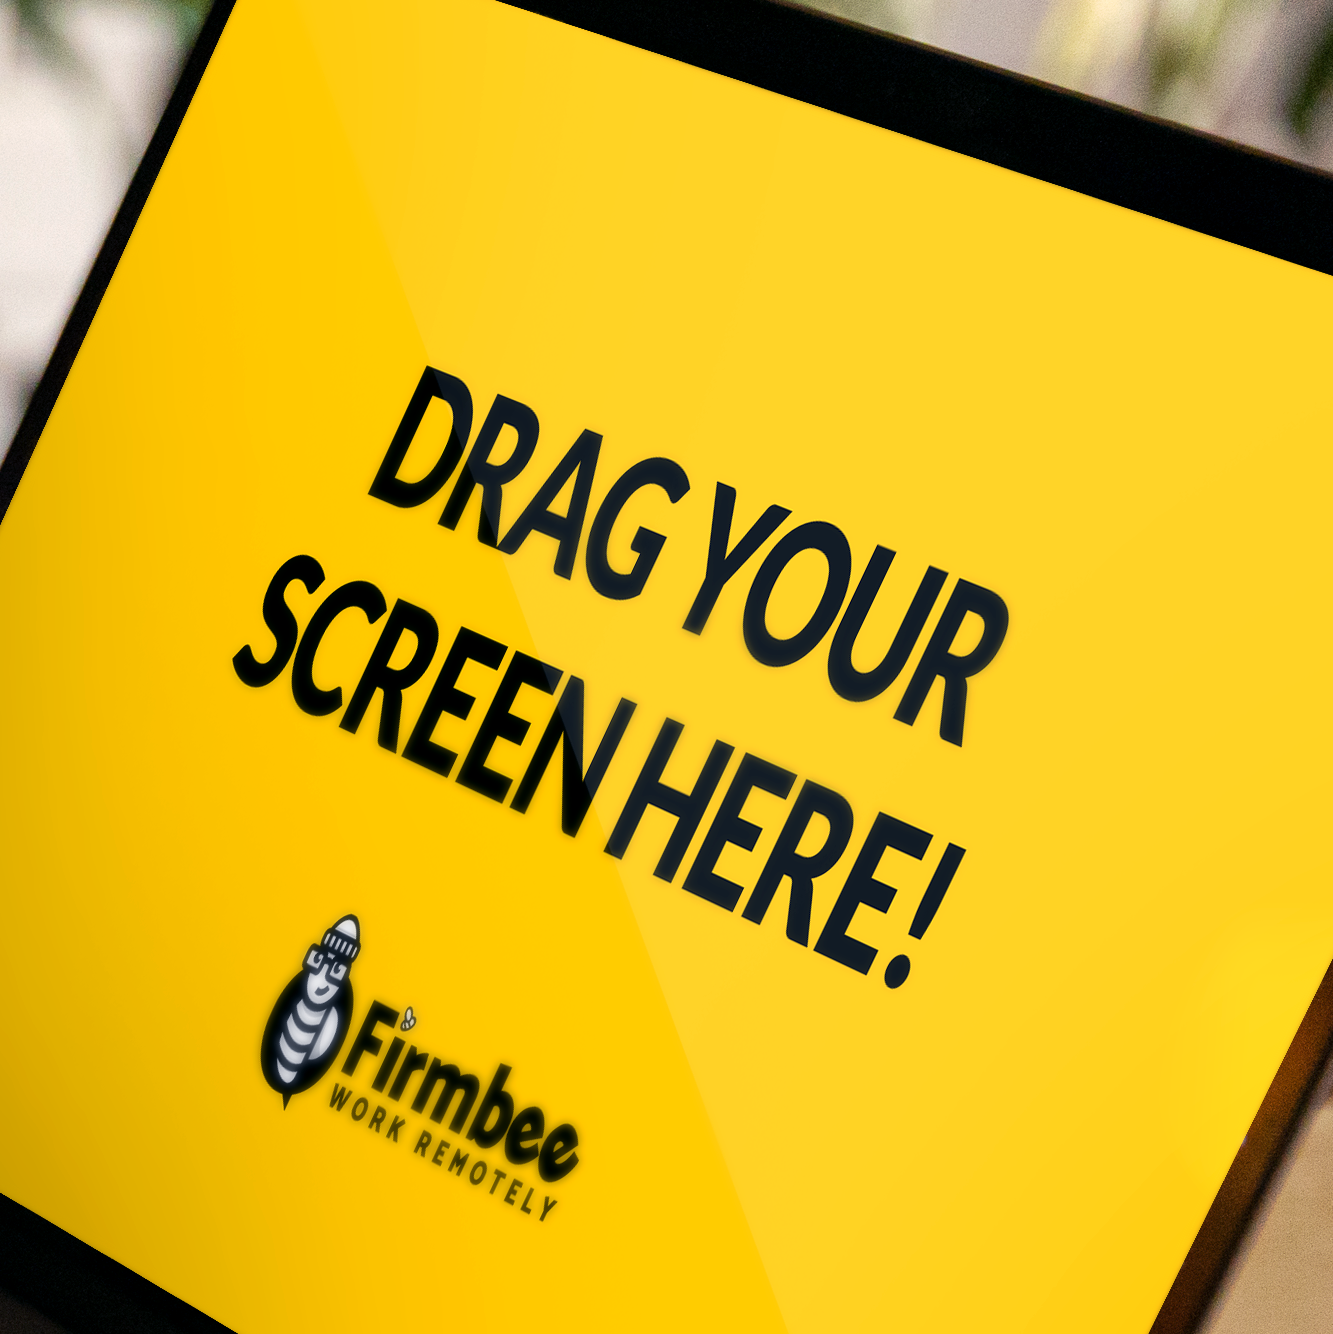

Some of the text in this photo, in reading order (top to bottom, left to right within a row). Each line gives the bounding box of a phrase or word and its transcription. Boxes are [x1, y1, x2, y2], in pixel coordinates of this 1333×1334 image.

[367, 365, 1009, 748] DRAG YOUR
[232, 554, 967, 989] SCREEN HERE!
[329, 1083, 558, 1222] WORK REMOTELY
[340, 999, 580, 1183] Firmbee
